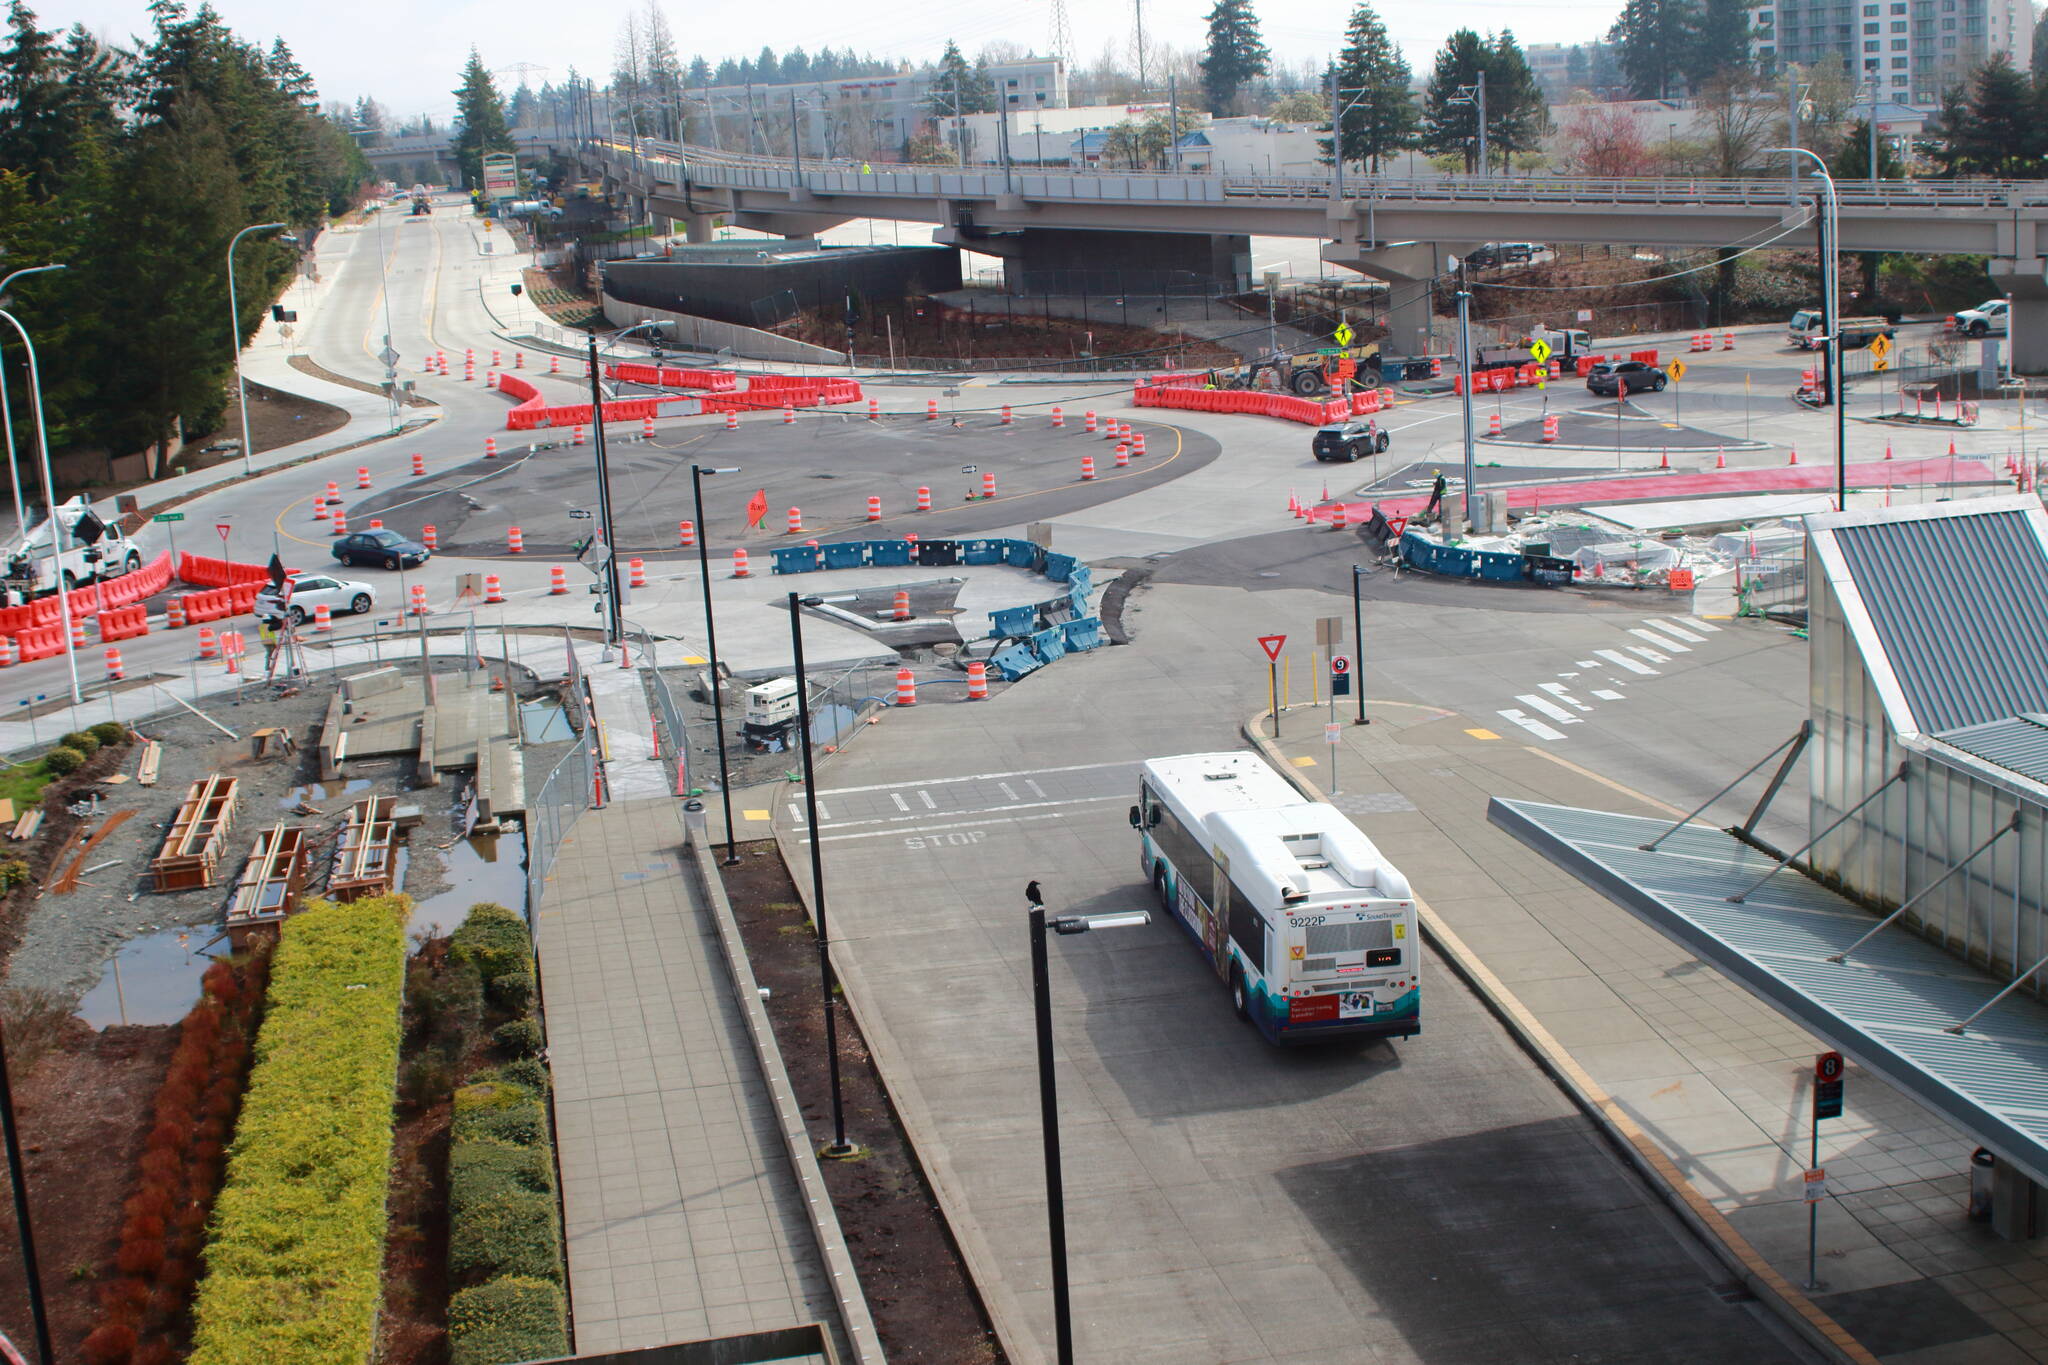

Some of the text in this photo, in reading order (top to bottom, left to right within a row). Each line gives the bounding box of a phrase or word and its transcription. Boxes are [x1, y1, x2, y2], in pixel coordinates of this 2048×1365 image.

[1336, 660, 1344, 670] 9
[904, 831, 986, 849] STOP
[1290, 916, 1326, 928] 9222P
[1825, 1059, 1835, 1075] 8
